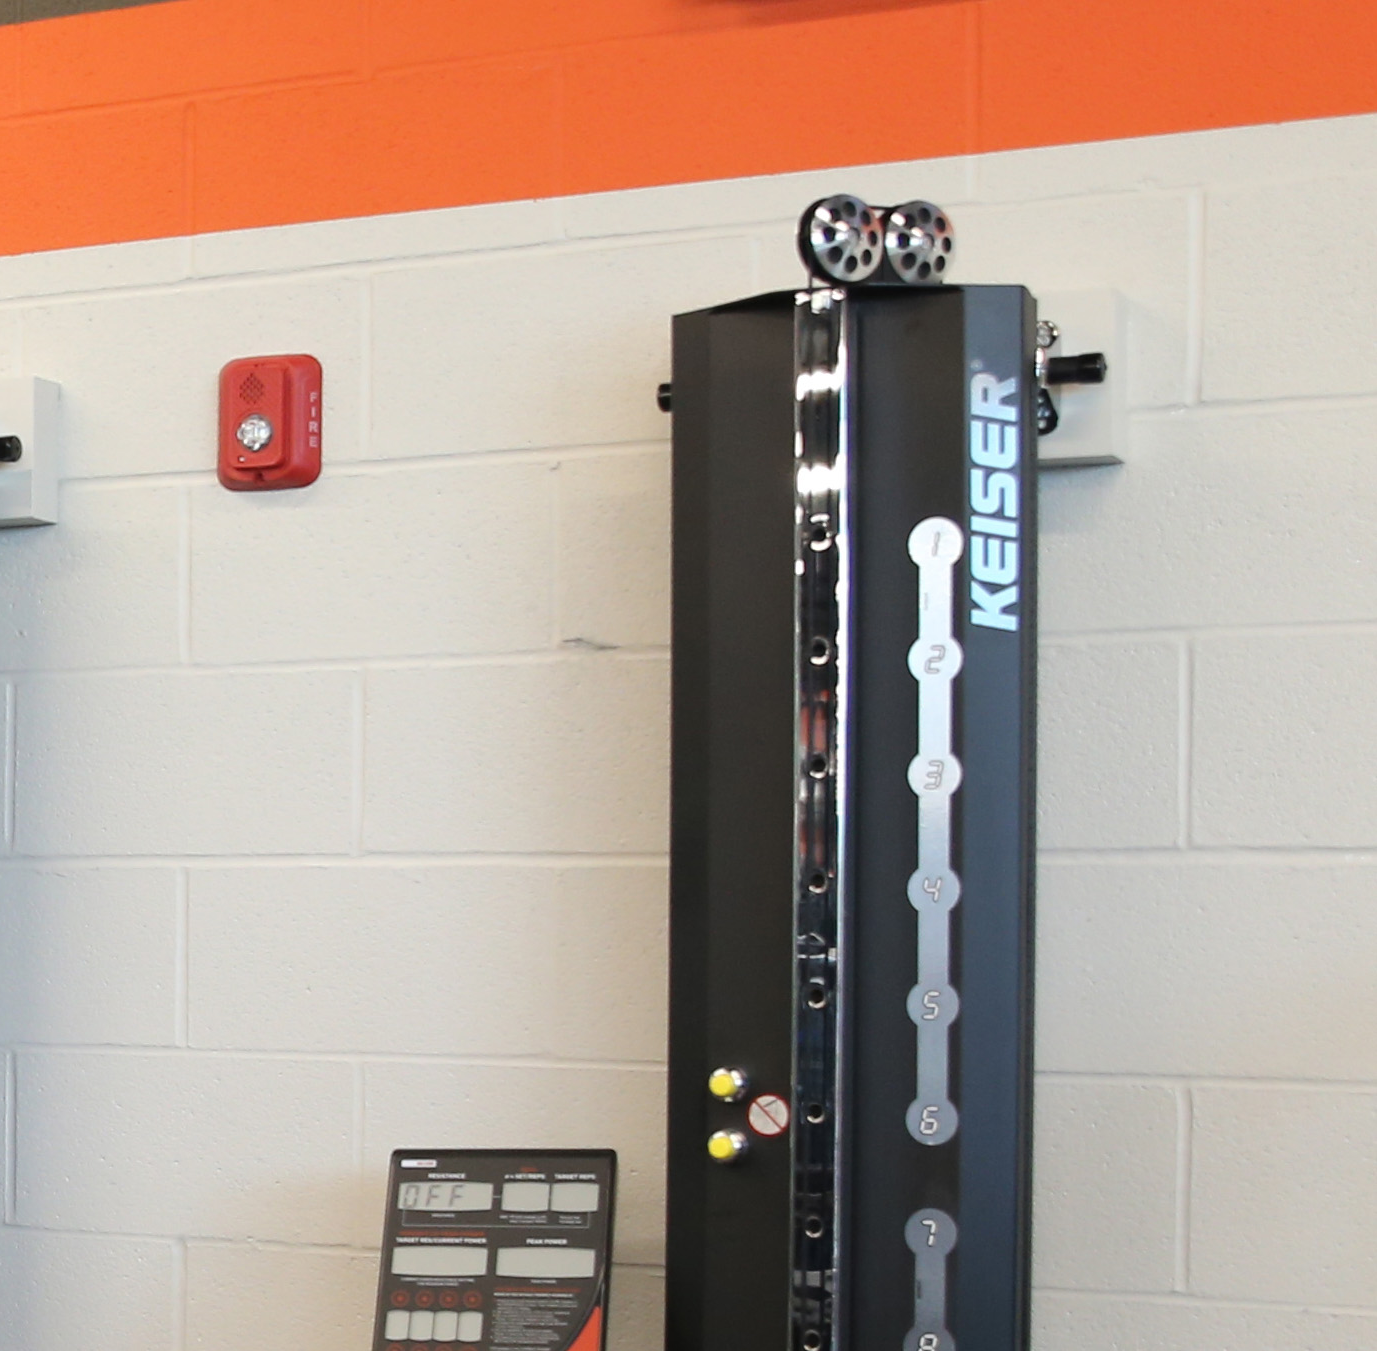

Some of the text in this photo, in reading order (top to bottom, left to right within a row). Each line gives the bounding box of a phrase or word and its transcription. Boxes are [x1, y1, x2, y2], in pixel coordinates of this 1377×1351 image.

[308, 391, 319, 448] FIRE
[969, 371, 1019, 632] KEISER
[924, 644, 946, 674] 2
[925, 760, 944, 790] 3
[923, 877, 942, 901] 4
[922, 991, 940, 1020] 5
[920, 1106, 938, 1136] 6
[921, 1219, 937, 1247] 7
